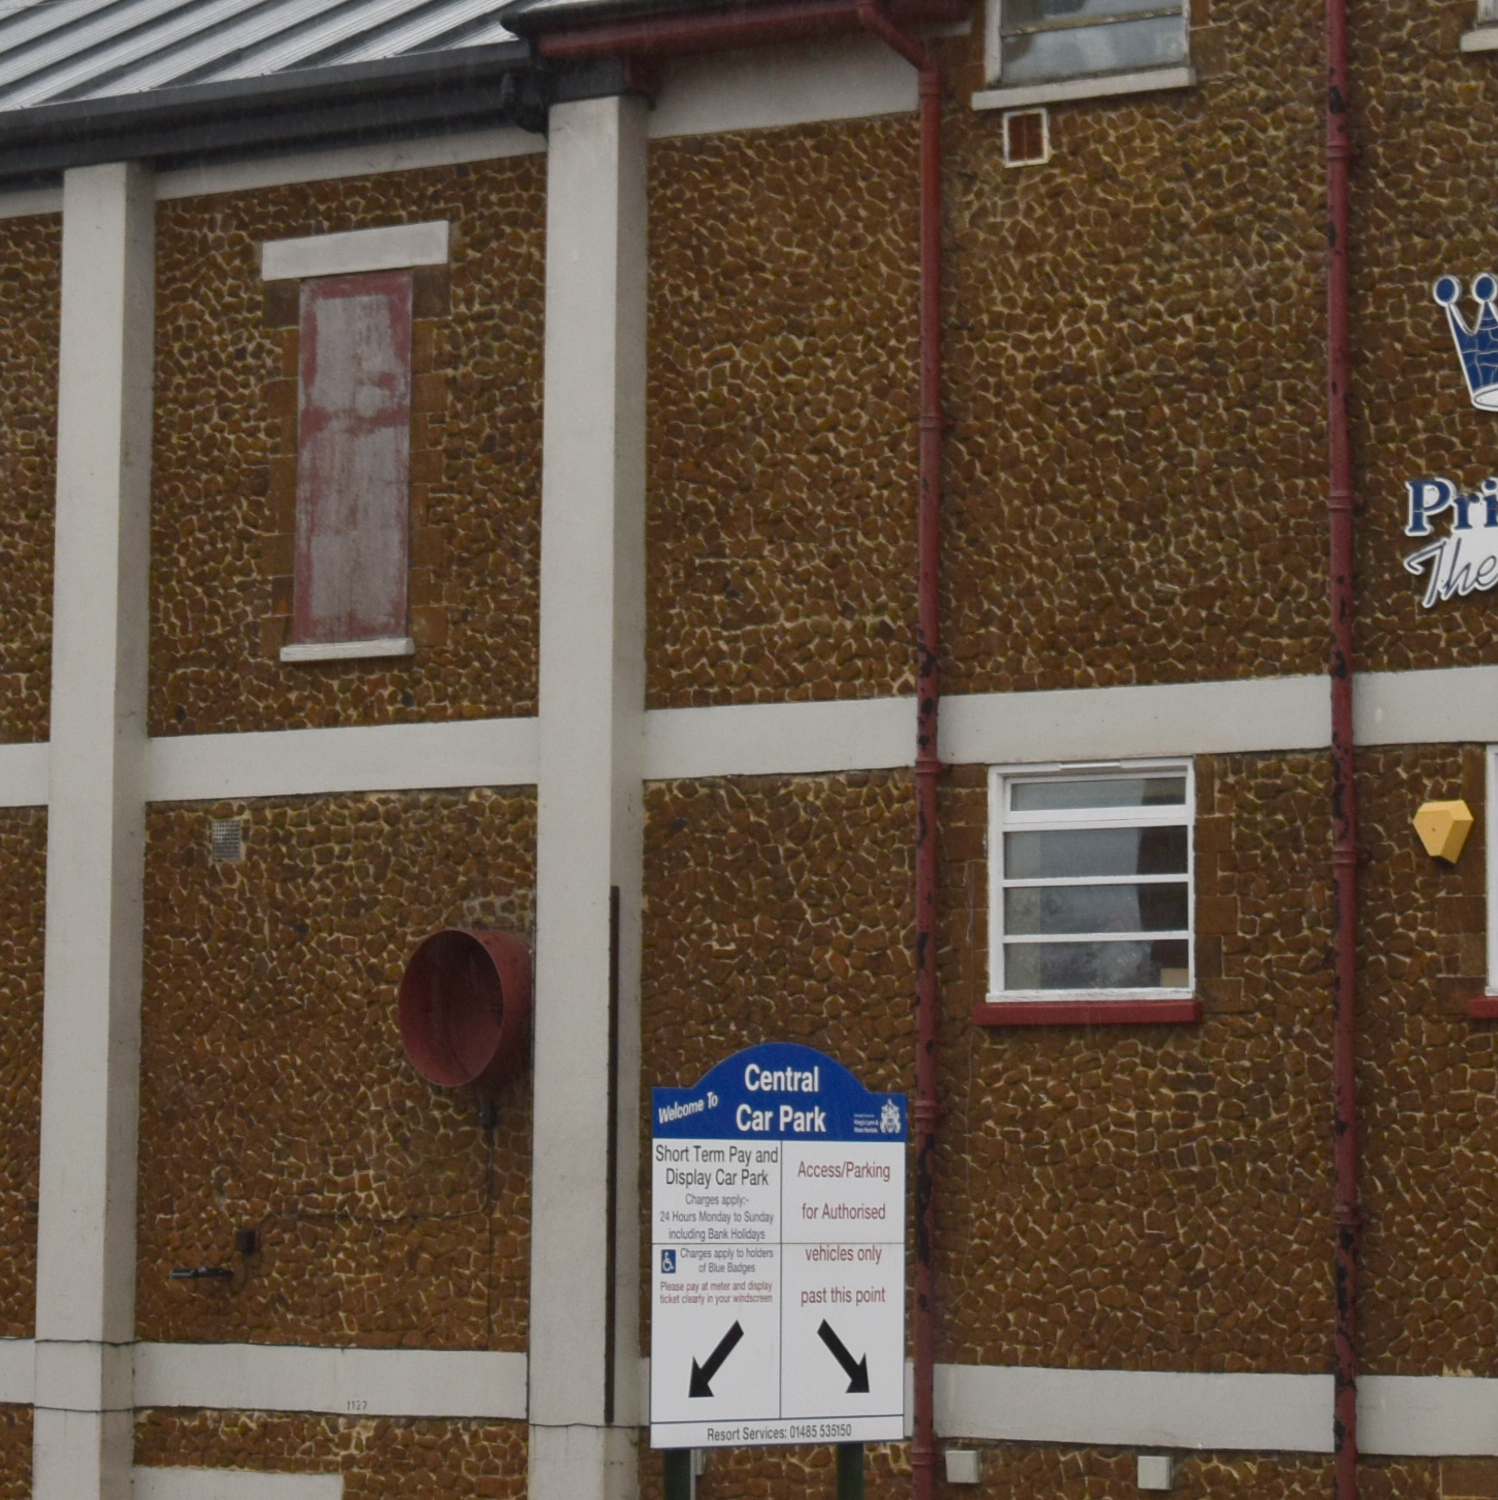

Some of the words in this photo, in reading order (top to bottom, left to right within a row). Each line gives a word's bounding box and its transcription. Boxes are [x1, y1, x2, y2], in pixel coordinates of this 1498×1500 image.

[744, 1063, 819, 1092] Central
[658, 1098, 704, 1124] Welcome
[706, 1091, 719, 1109] To
[736, 1103, 774, 1132] Car
[779, 1104, 827, 1133] Park
[655, 1144, 689, 1162] Short
[693, 1145, 724, 1162] Term
[729, 1145, 752, 1167] Pay
[755, 1146, 778, 1163] and
[666, 1167, 712, 1189] Display
[715, 1168, 737, 1186] Car
[741, 1168, 769, 1186] Park
[797, 1160, 891, 1182] Access/Parking
[685, 1193, 719, 1207] Charges
[660, 1211, 670, 1222] 24
[672, 1211, 696, 1222] Hours
[699, 1210, 731, 1224] Monday
[733, 1211, 742, 1222] to
[744, 1211, 774, 1225] Sunday
[801, 1202, 819, 1219] for
[821, 1202, 885, 1220] Authorised
[668, 1228, 706, 1242] including
[708, 1228, 729, 1239] Bank
[731, 1228, 765, 1242] Holidays
[679, 1247, 712, 1260] Charges
[714, 1247, 734, 1260] apply
[736, 1248, 743, 1258] to
[746, 1247, 773, 1258] holders
[805, 1245, 853, 1261] vehicles
[857, 1244, 882, 1265] only
[698, 1262, 707, 1273] of
[708, 1262, 725, 1273] Blue
[727, 1262, 755, 1275] Badges
[660, 1281, 684, 1291] Please
[686, 1283, 699, 1293] pay
[701, 1282, 709, 1291] at
[710, 1281, 730, 1291] meter
[732, 1281, 746, 1290] and
[747, 1281, 773, 1292] display
[660, 1294, 680, 1304] ticket
[682, 1294, 705, 1305] clearly
[706, 1294, 714, 1304] in
[715, 1295, 731, 1305] your
[733, 1293, 773, 1303] windscreen
[801, 1287, 827, 1307] past
[830, 1286, 852, 1303] this
[856, 1286, 885, 1306] point
[346, 1400, 368, 1411] 1127
[707, 1427, 740, 1442] Resort
[742, 1426, 787, 1441] Services:
[789, 1424, 817, 1439] 01485
[819, 1423, 852, 1438] 535150
